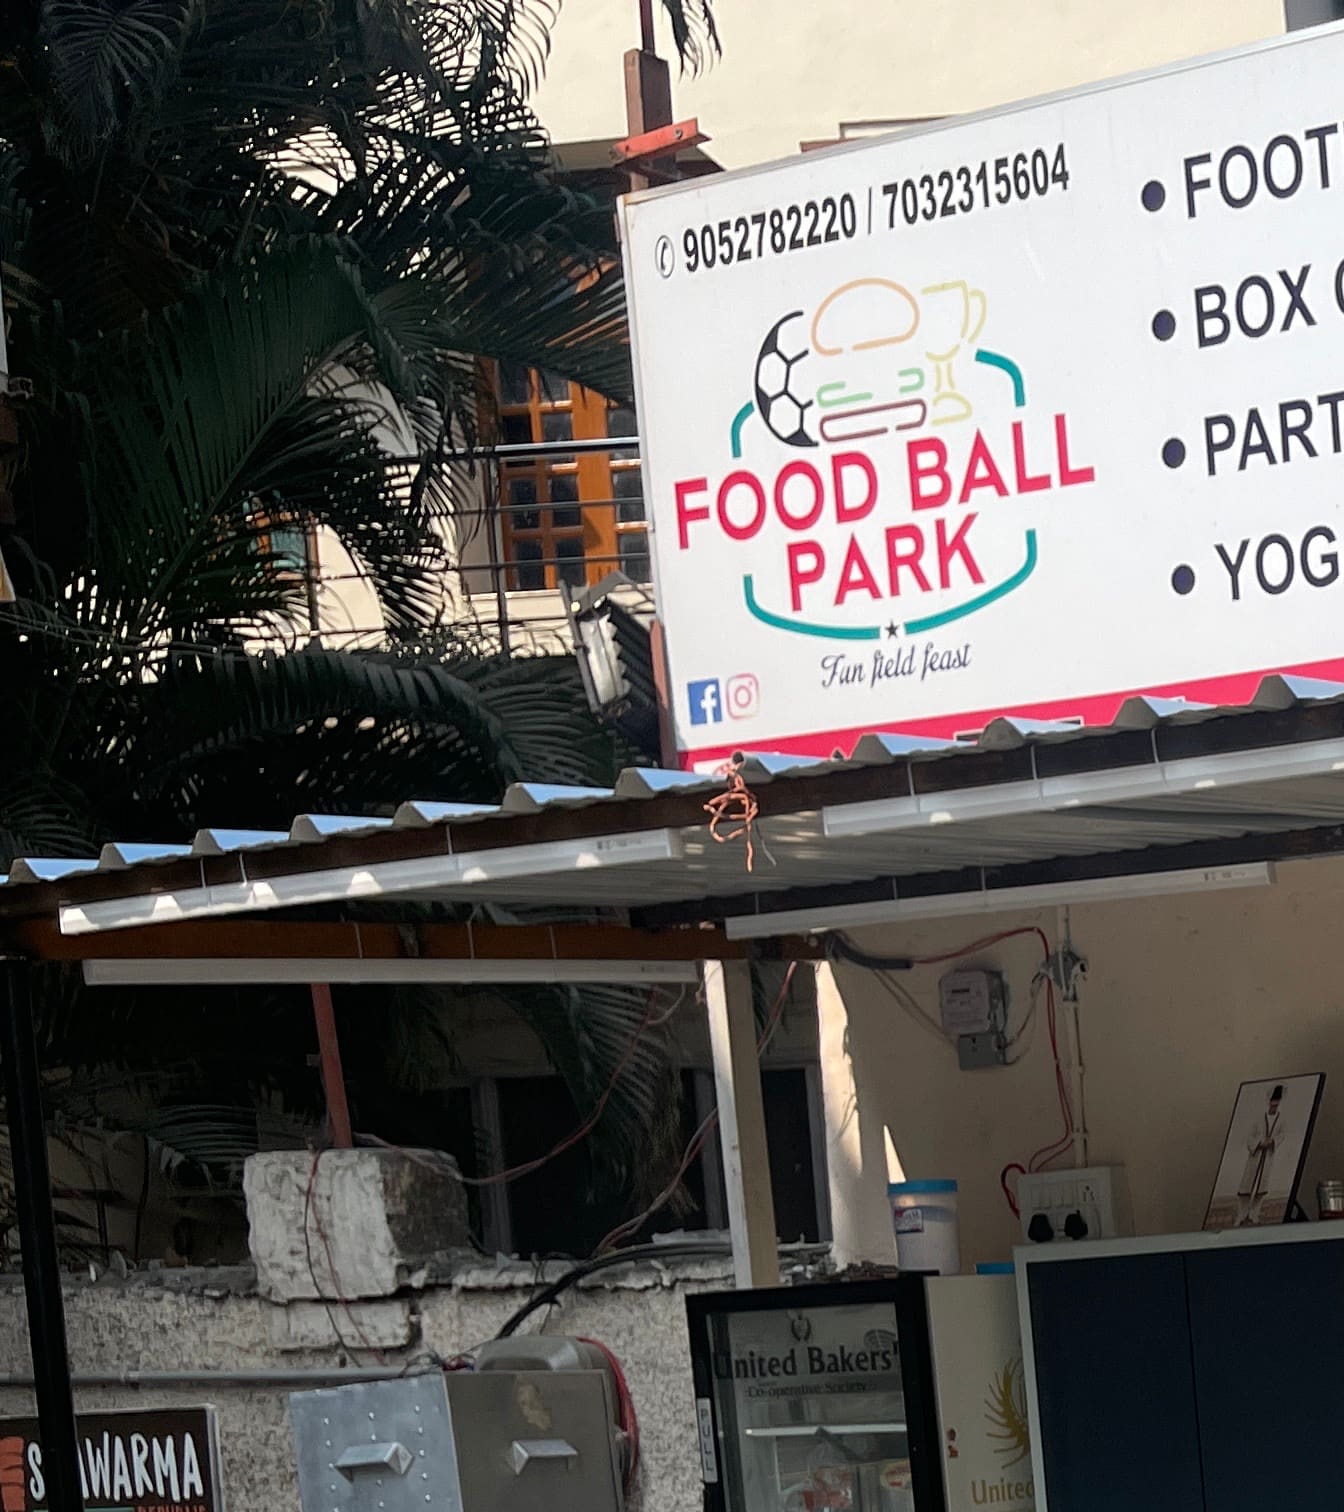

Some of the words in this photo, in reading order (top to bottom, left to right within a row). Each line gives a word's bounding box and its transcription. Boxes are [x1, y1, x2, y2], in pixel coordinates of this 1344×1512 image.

[682, 193, 857, 272] 9052782220
[882, 143, 1070, 231] 7032315604
[1194, 264, 1316, 348] BOX
[674, 450, 879, 549] FOOD
[907, 413, 1095, 511] BALL
[787, 512, 984, 612] PARK
[820, 652, 865, 689] Fun
[871, 646, 916, 685] field
[920, 641, 973, 680] feast
[714, 1348, 798, 1379] United
[28, 1431, 204, 1502] SWARMA
[700, 1410, 716, 1473] PULL
